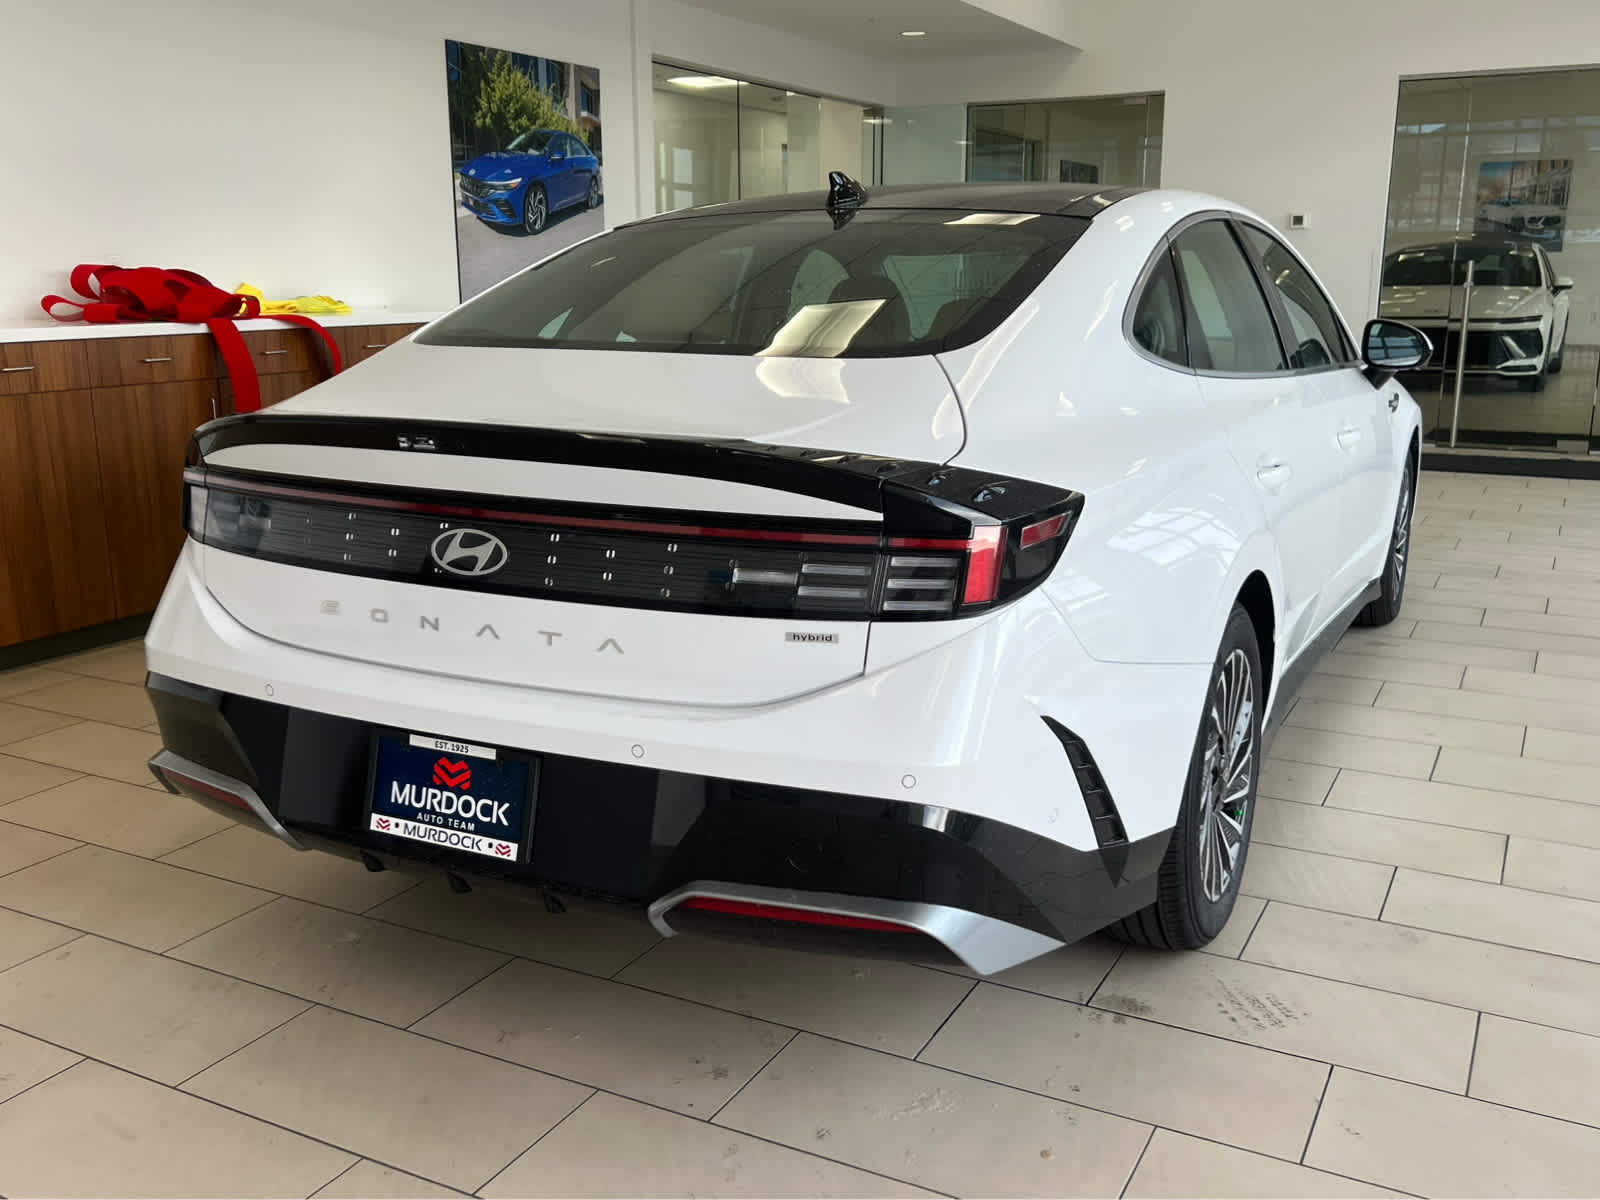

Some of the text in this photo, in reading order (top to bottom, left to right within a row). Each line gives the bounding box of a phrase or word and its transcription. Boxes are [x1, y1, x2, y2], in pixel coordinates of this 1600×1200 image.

[792, 632, 833, 642] hybrid
[451, 743, 469, 754] 1925
[391, 780, 510, 826] MURDOCK
[416, 812, 475, 832] AUTO TEAM
[403, 823, 482, 851] MURDOCK
